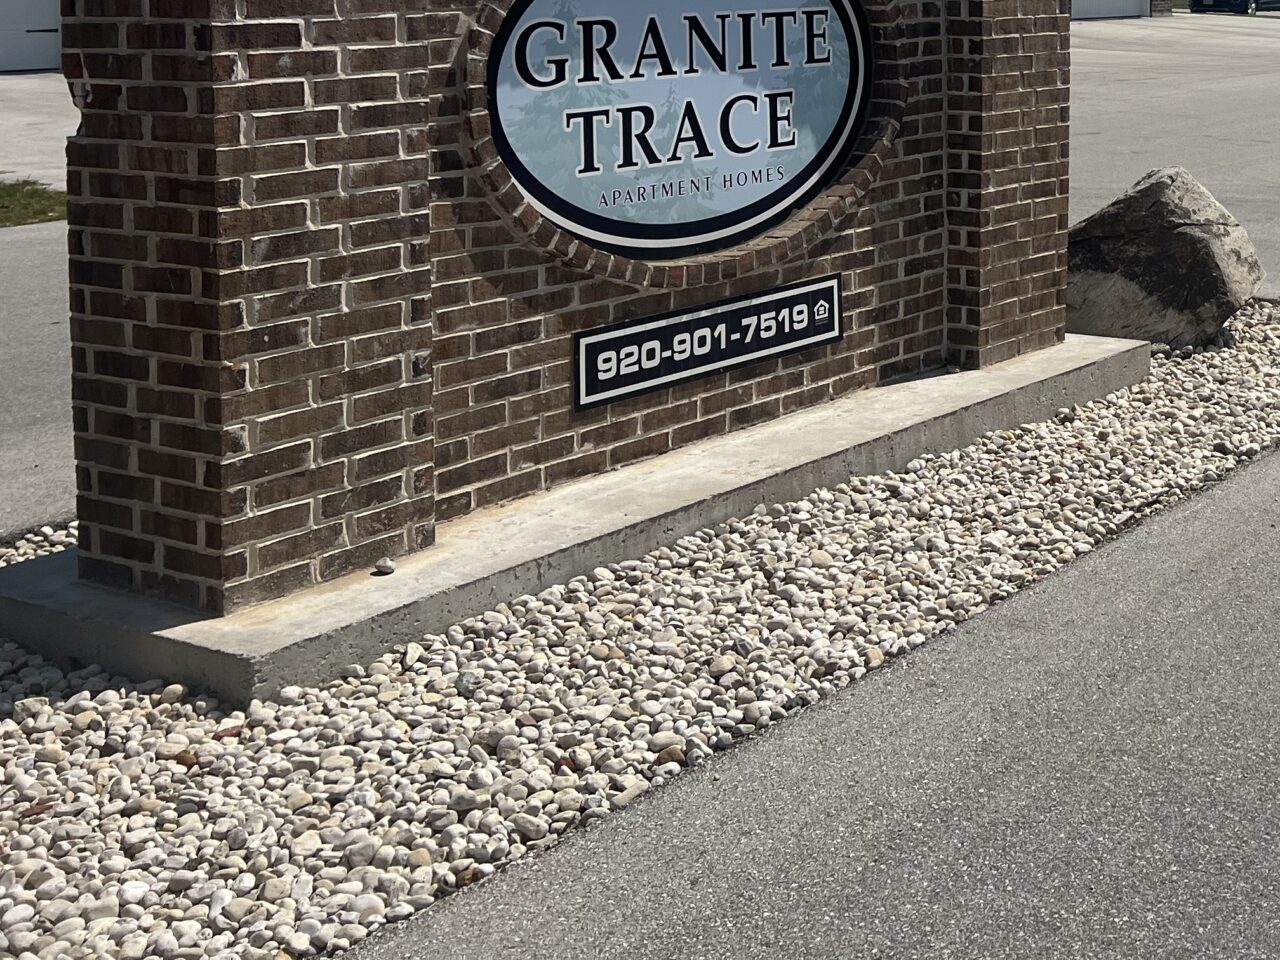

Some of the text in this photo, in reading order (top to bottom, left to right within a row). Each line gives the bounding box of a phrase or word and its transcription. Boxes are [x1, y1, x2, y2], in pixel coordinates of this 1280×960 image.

[513, 9, 832, 89] GRANITE
[565, 91, 797, 175] TRACE
[599, 166, 785, 208] APARTMENT HOMES
[597, 303, 809, 381] 920-901-7519
